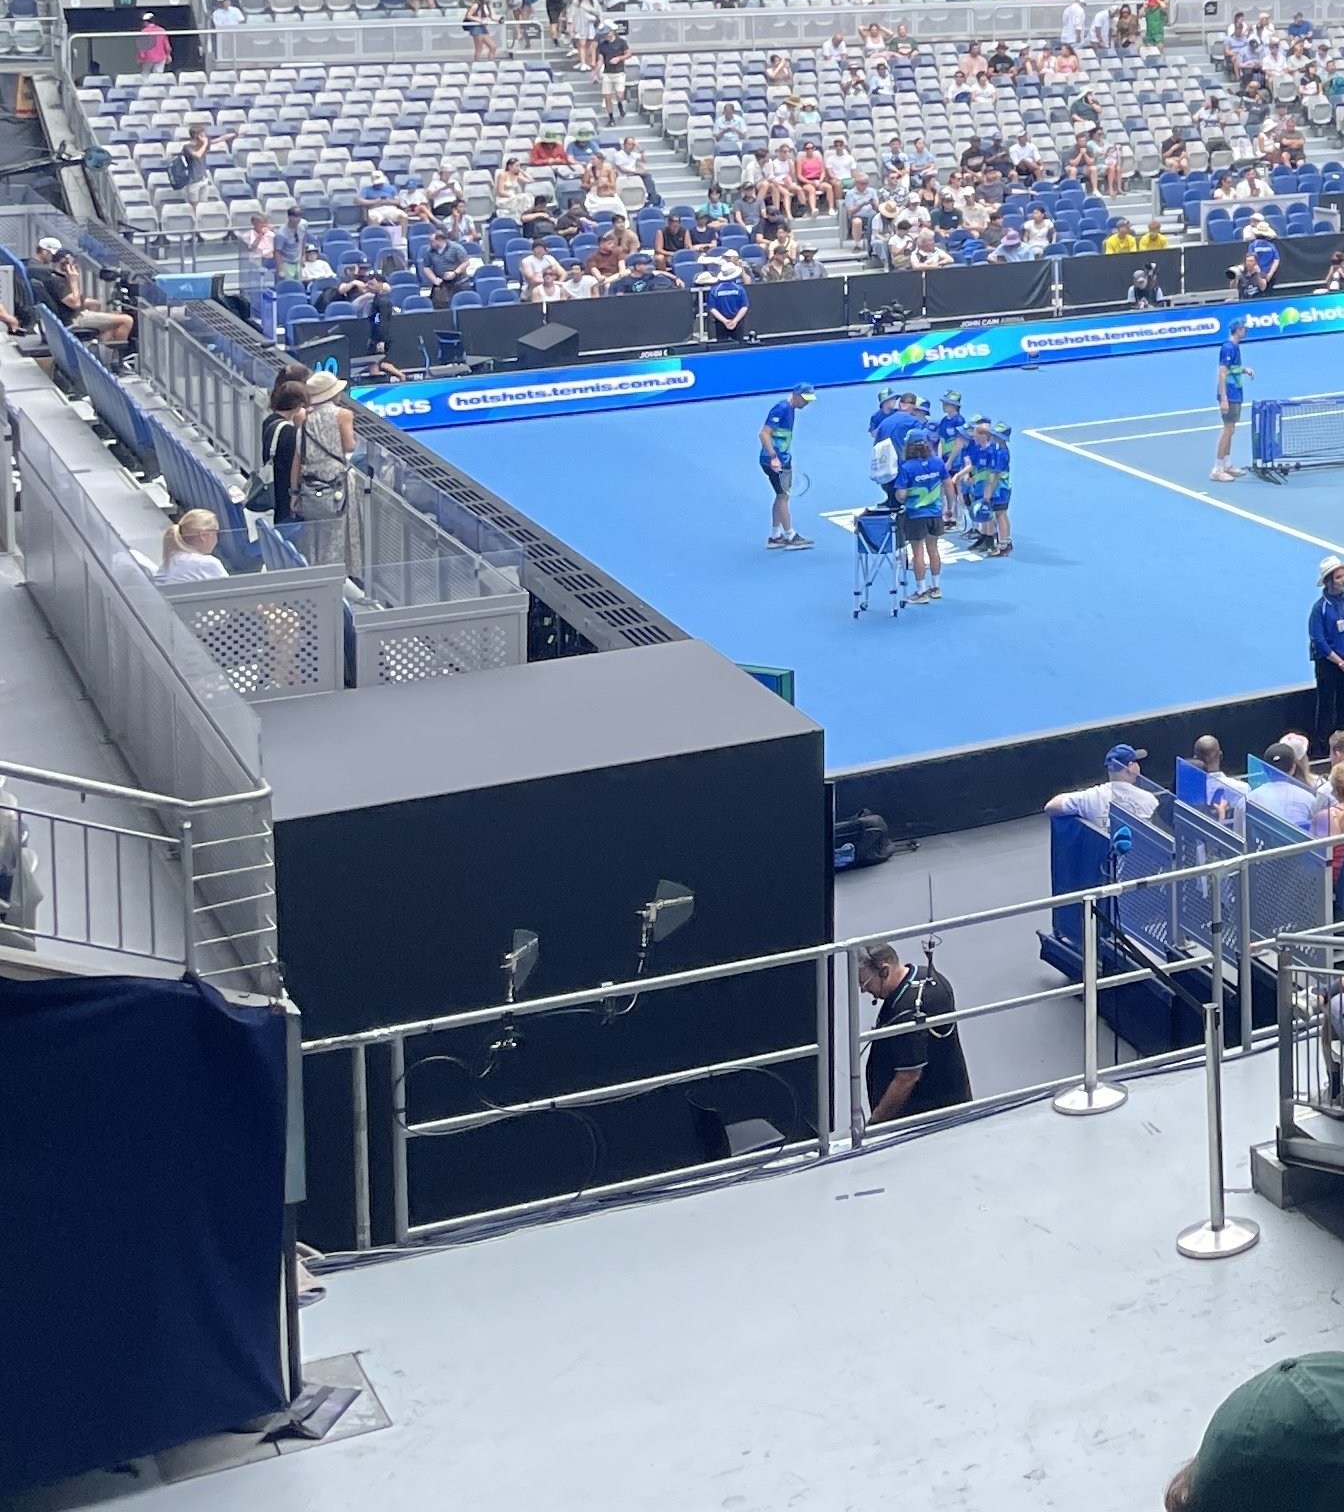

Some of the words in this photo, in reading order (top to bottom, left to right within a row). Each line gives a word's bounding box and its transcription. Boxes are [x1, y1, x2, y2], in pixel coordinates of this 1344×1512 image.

[1245, 312, 1280, 328] hot
[1027, 322, 1215, 349] hotshots.tennis.com.au
[862, 349, 900, 369] hot
[925, 343, 991, 361] shots
[365, 398, 432, 417] hots
[456, 376, 689, 406] hotshots.tennis.com.au
